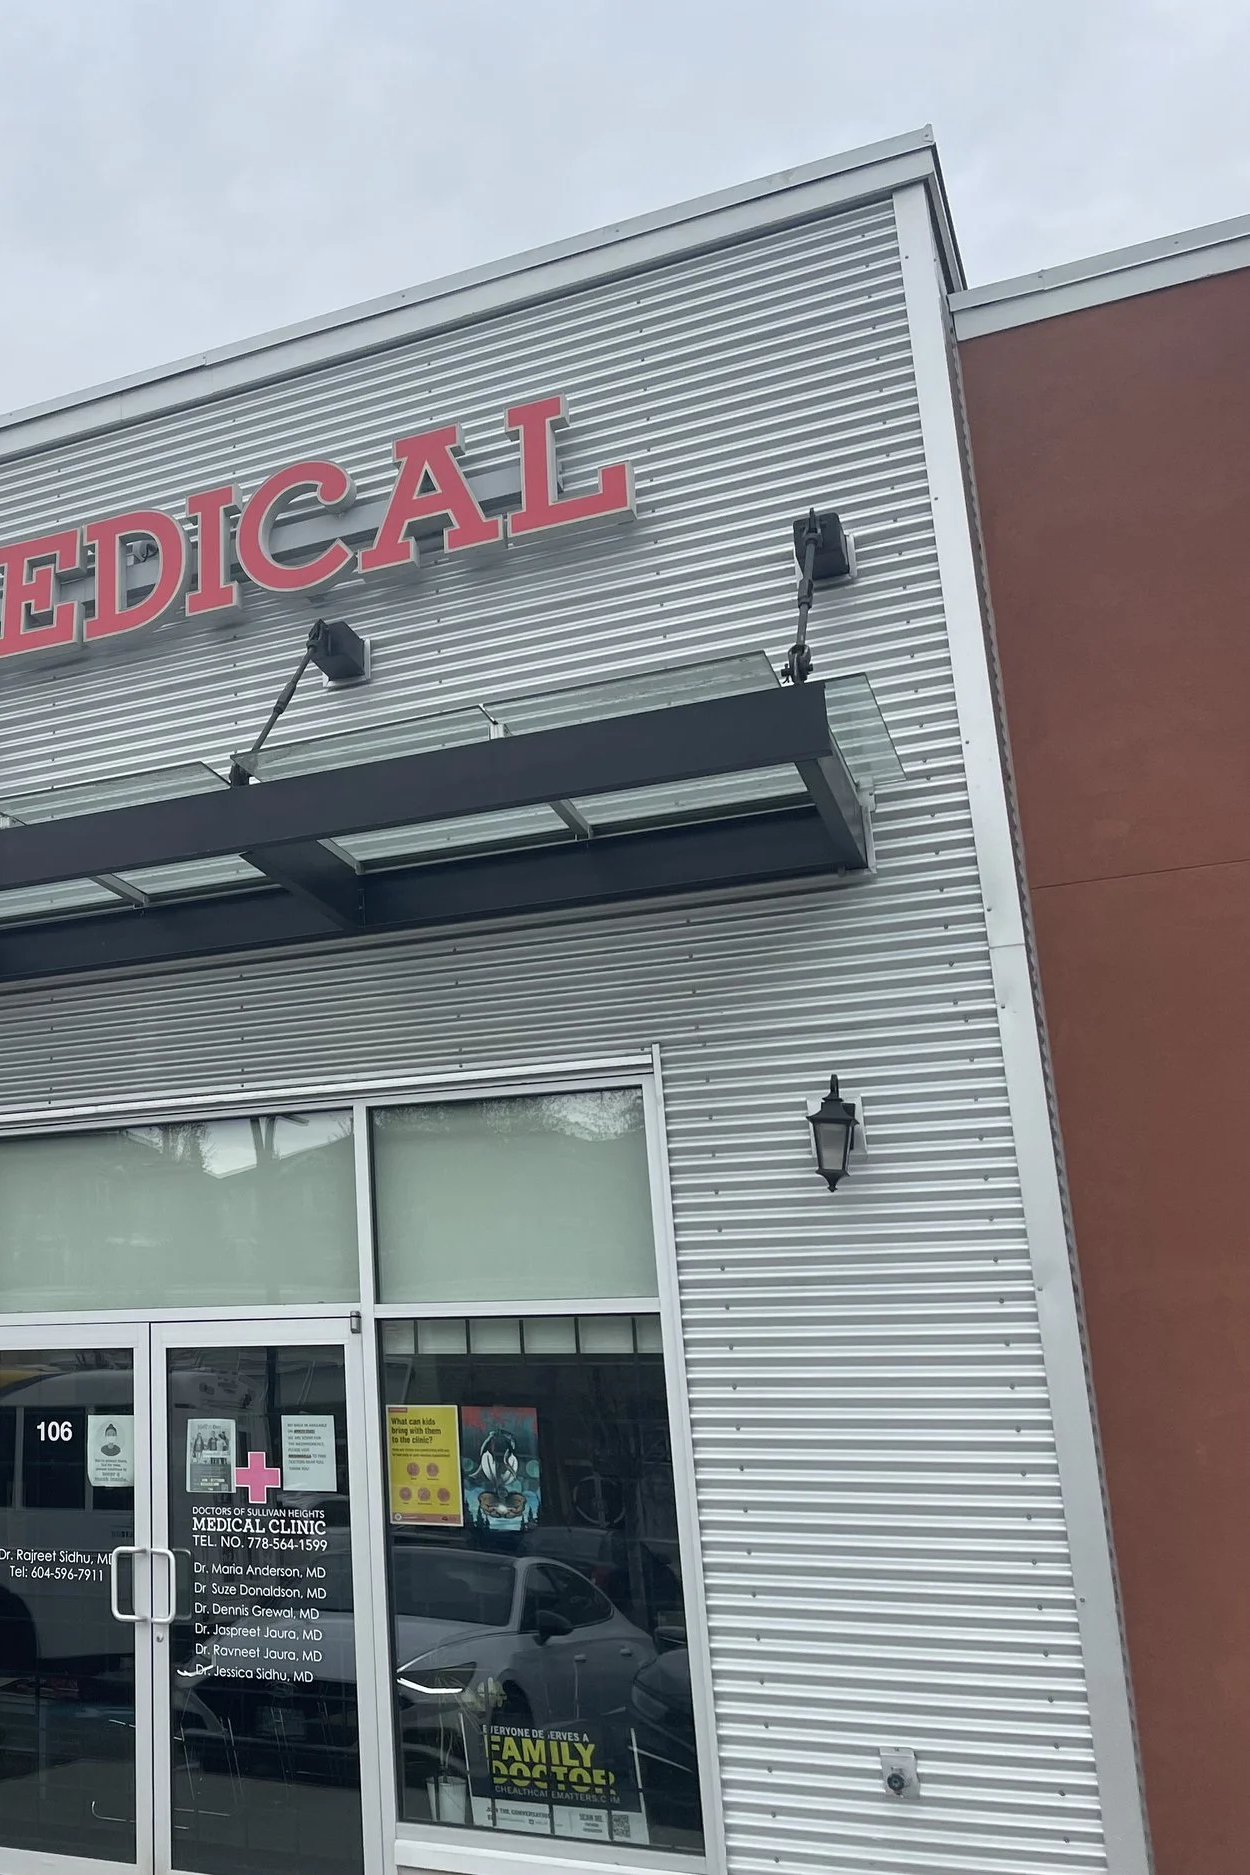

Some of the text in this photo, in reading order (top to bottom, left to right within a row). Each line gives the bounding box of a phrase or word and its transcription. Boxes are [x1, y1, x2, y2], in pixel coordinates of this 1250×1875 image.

[36, 1421, 72, 1441] 106
[192, 1507, 325, 1518] DOCTORS OF SULLIVAN HEIGHTS
[192, 1517, 326, 1535] MEDICAL CLINIC
[192, 1535, 328, 1551] TEL. NO. 778-564-1599
[16, 1549, 56, 1564] Rajreet
[59, 1550, 94, 1564] Sidhu,
[10, 1566, 103, 1581] Tel: 604-596-7911
[194, 1562, 326, 1578] Dr. Maria Anderson, MD
[212, 1583, 236, 1595] Suze
[239, 1584, 303, 1599] Donaldson,
[307, 1588, 326, 1599] MD
[194, 1603, 320, 1620] Dr. Dennis Grewal, MD
[195, 1623, 322, 1640] Dr. Jaspreet Jaura, MD
[195, 1644, 322, 1662] Dr. Ravneet Jaura, MD
[196, 1664, 313, 1682] Dr. Jessica Sidhu, MD
[532, 1729, 580, 1742] DEERVES
[582, 1734, 589, 1742] A
[484, 1734, 595, 1767] FAMILY
[493, 1760, 617, 1796] DOCTOR
